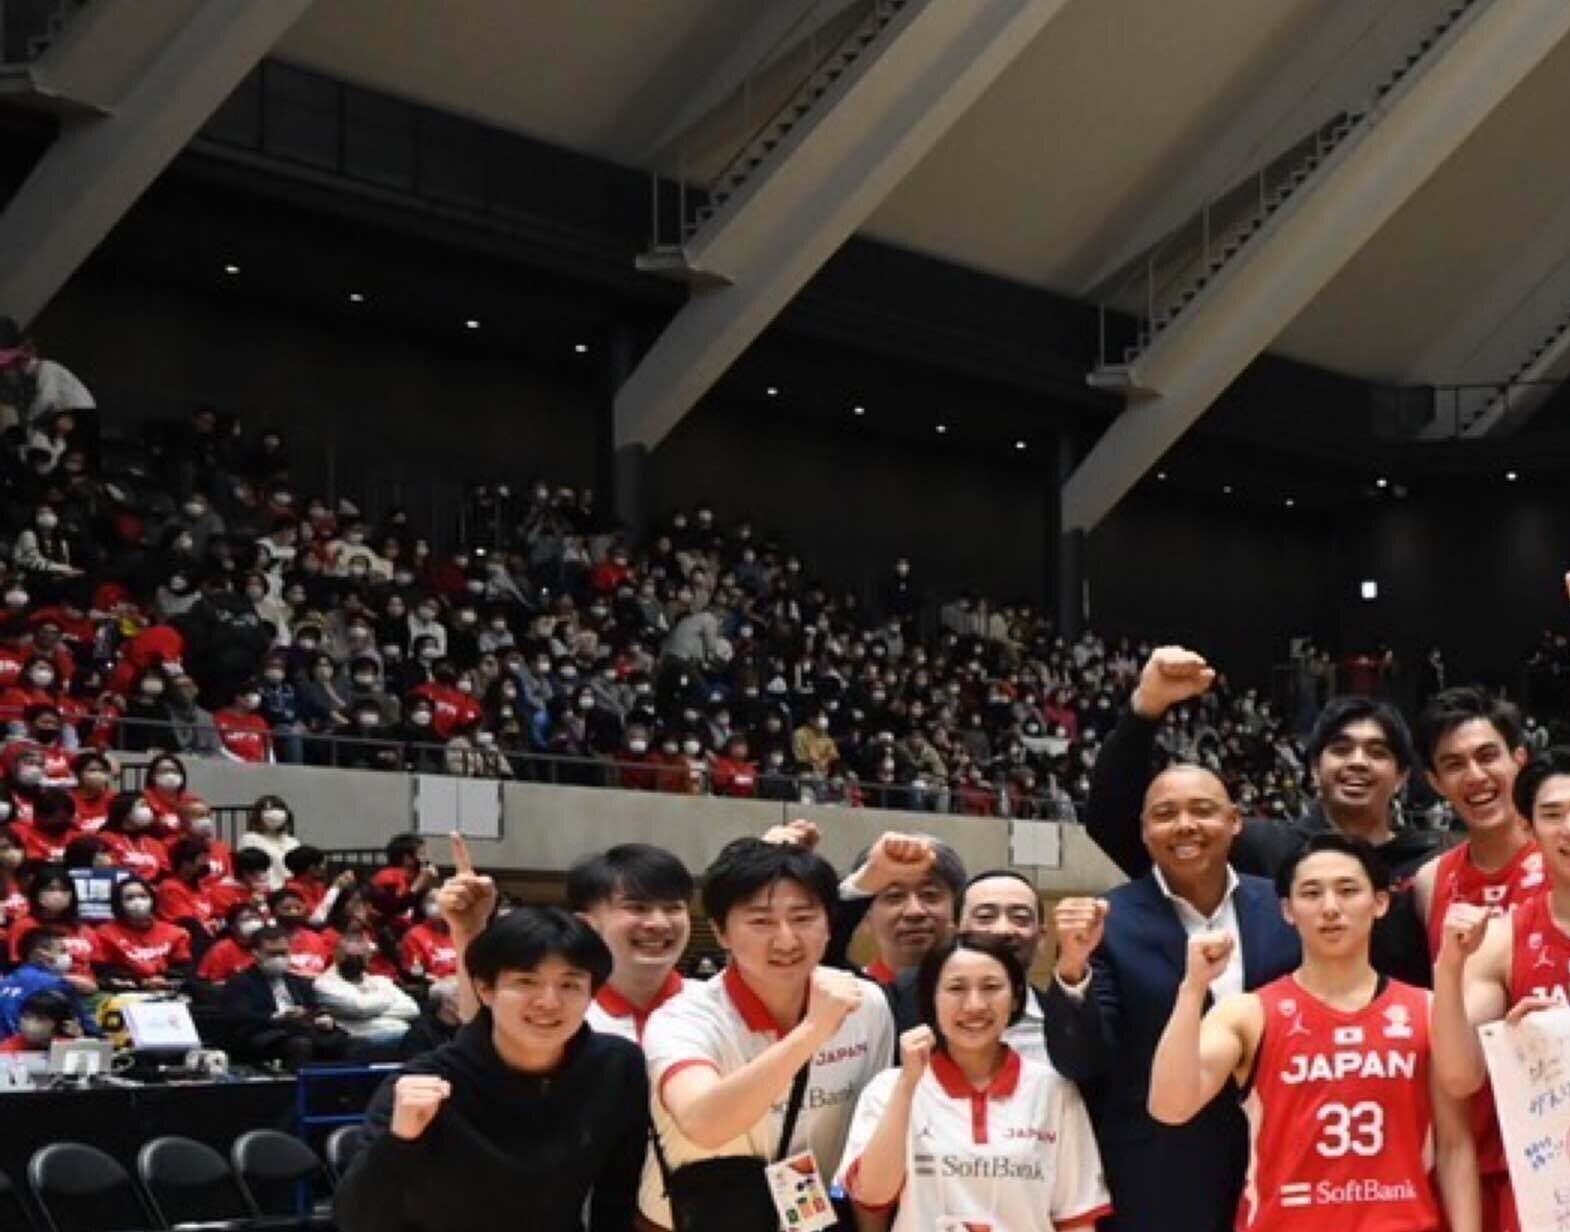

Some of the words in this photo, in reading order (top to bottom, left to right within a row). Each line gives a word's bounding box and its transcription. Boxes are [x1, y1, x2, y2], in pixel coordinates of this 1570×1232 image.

[815, 1043, 868, 1067] JAPAN
[1280, 1051, 1417, 1085] JAPAN
[1004, 1126, 1058, 1145] JAPAN
[1315, 1101, 1385, 1157] 33
[940, 1153, 1045, 1181] SoftBank
[1315, 1179, 1418, 1204] SoftBank
